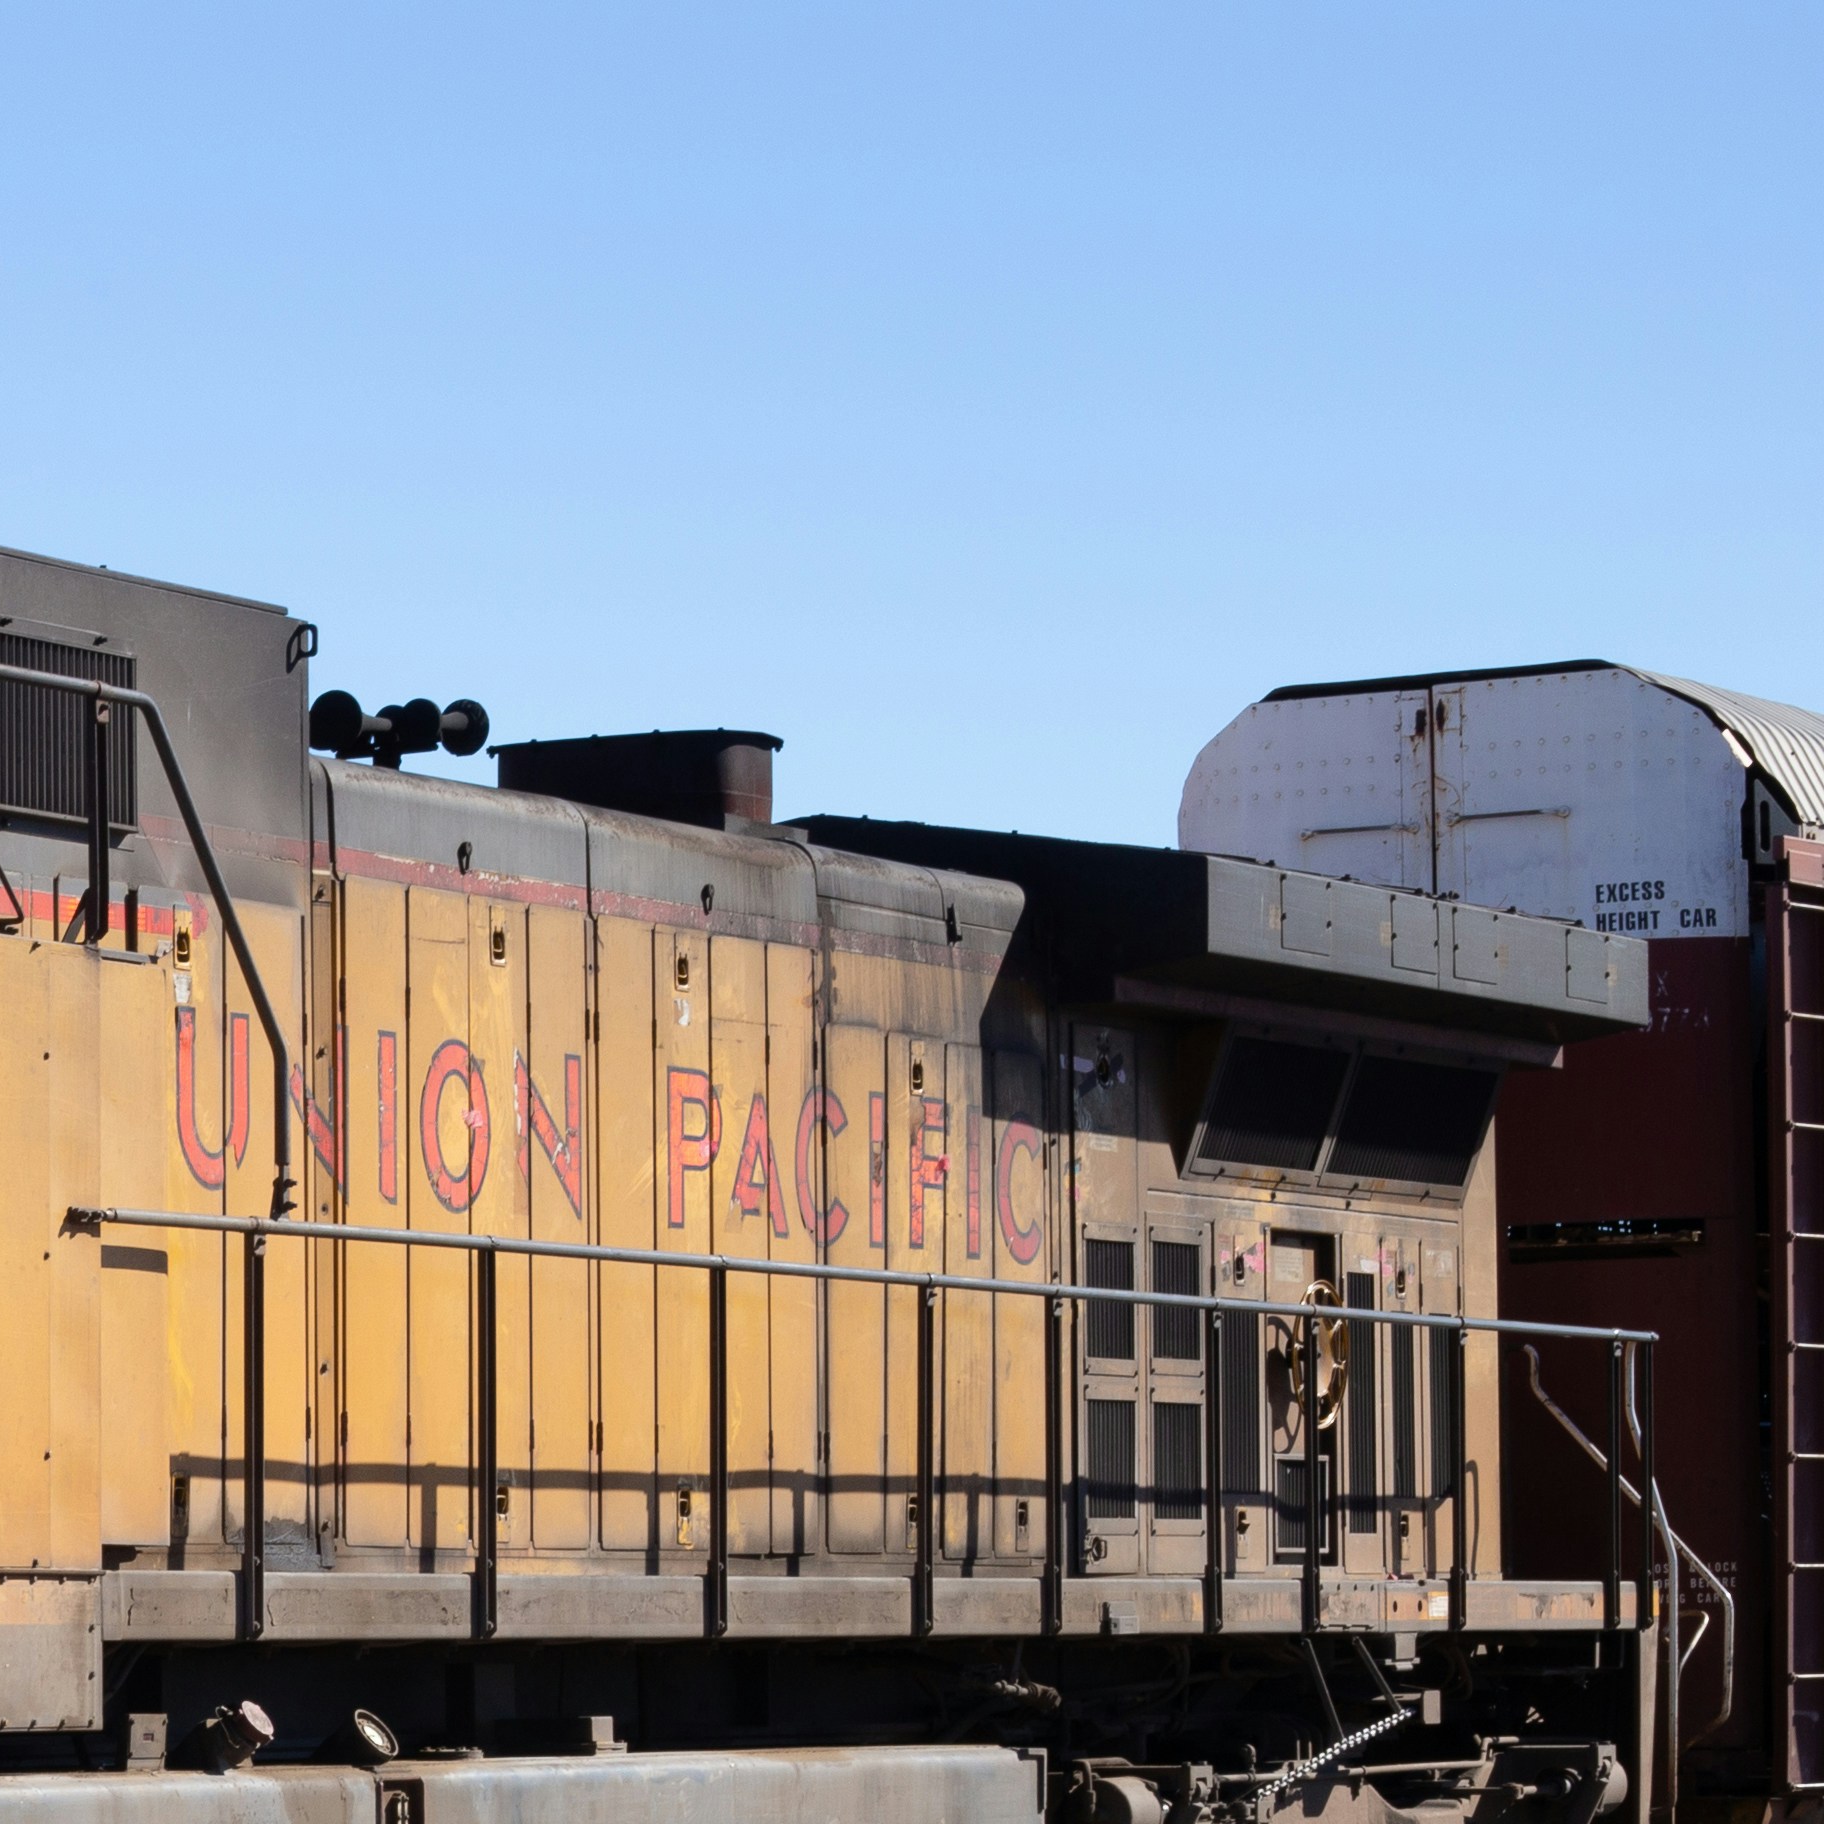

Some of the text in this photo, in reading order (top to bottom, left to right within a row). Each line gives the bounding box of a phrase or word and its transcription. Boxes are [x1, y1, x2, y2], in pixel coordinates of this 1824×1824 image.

[1595, 880, 1666, 904] EXCESS
[1596, 907, 1718, 932] HEIGHT CAR
[175, 1005, 1042, 1266] UNION PACIFIC
